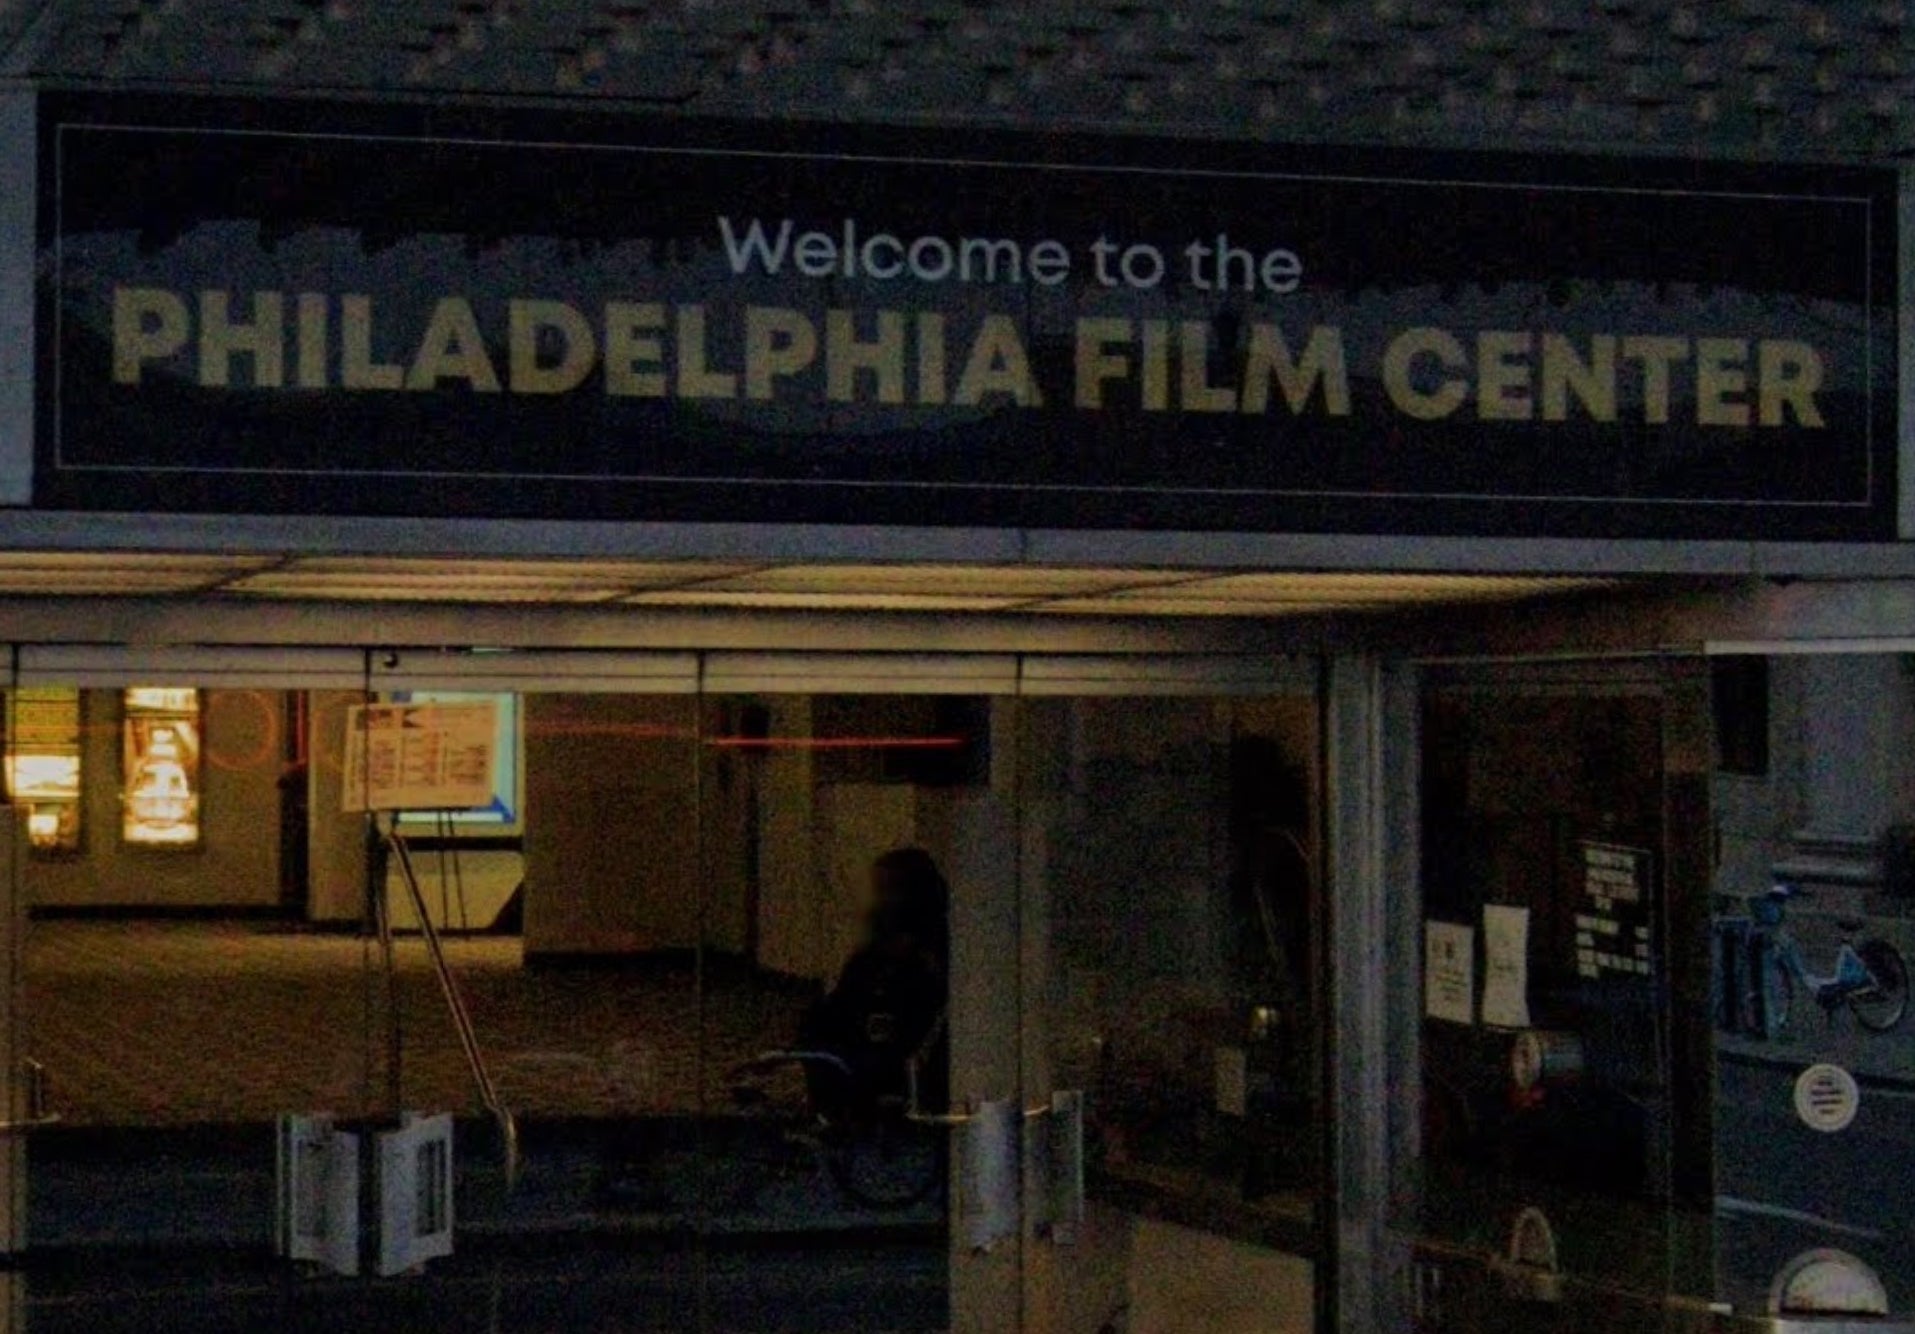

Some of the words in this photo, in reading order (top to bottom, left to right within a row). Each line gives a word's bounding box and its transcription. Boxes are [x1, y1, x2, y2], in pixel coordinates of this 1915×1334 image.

[719, 215, 1071, 283] Welcome
[1090, 238, 1162, 288] to
[1187, 234, 1303, 295] the
[112, 288, 1042, 408] PHILADELPHIA
[1076, 318, 1349, 416] FILM
[1383, 327, 1825, 428] CENTER
